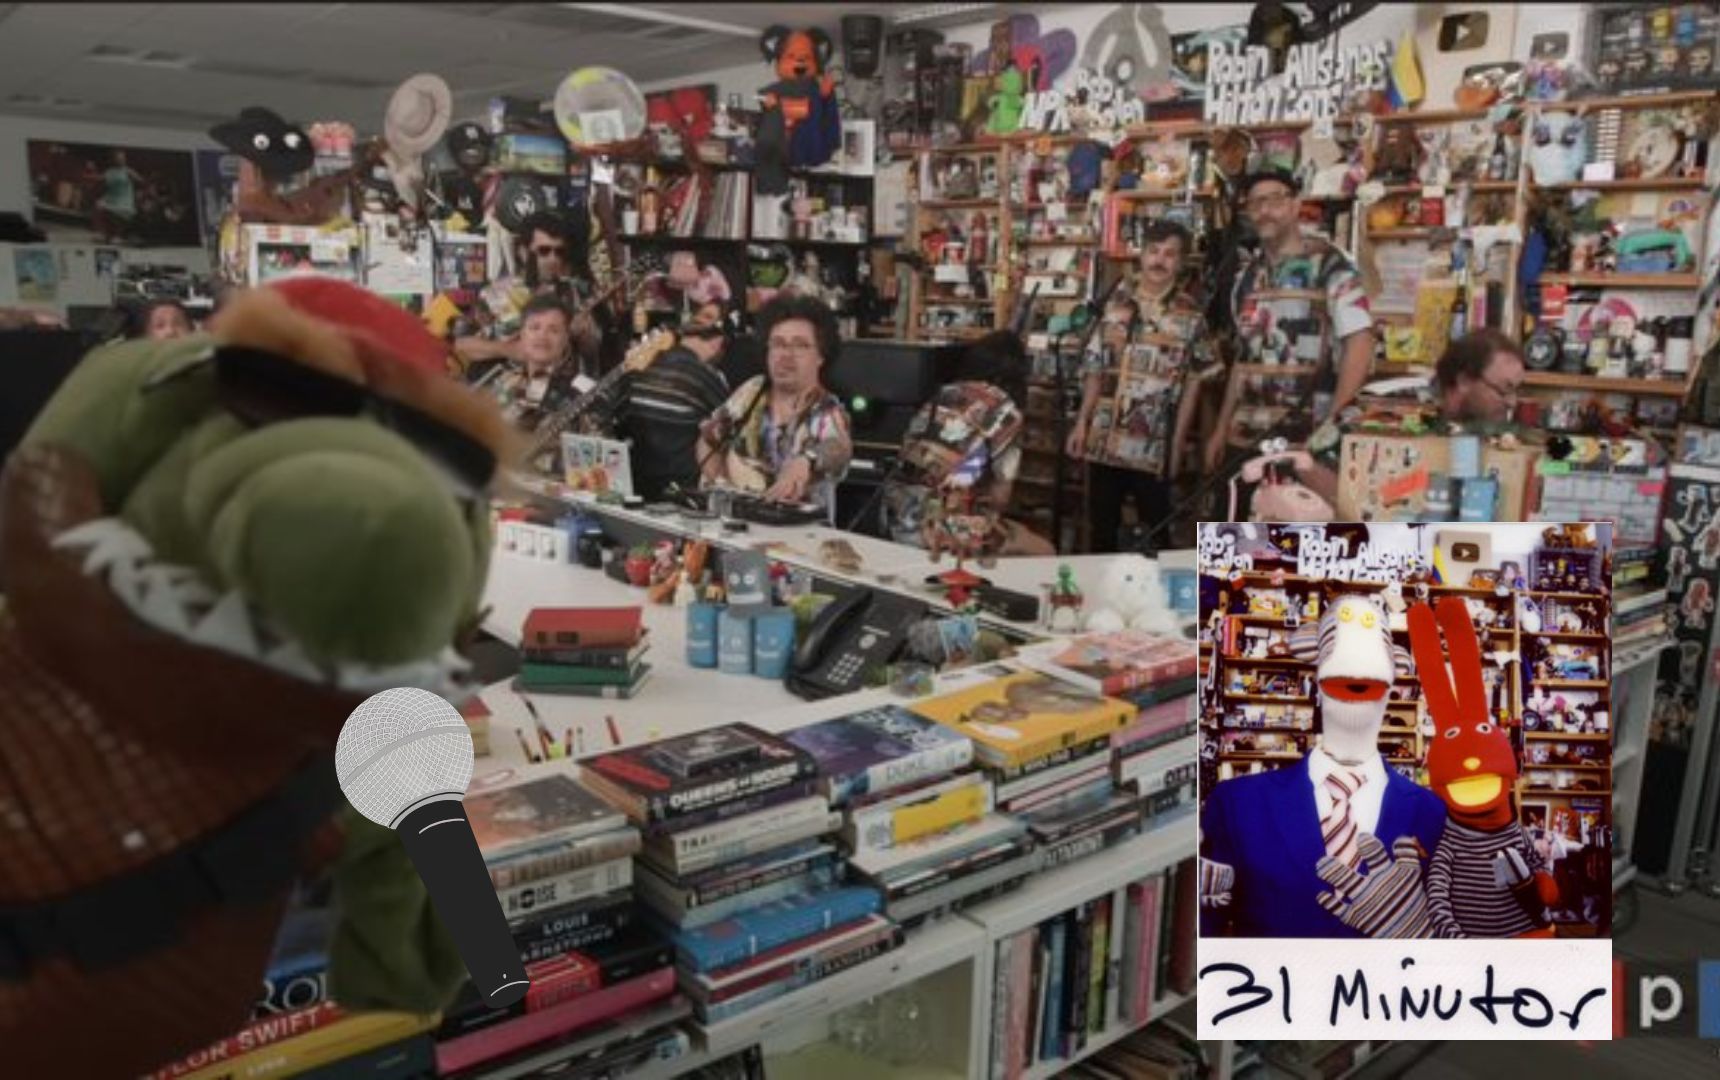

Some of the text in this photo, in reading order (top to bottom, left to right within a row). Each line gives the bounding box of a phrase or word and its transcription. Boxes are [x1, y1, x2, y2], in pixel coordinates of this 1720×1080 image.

[1206, 39, 1270, 83] Robin
[1199, 962, 1292, 1025] 31
[236, 1009, 320, 1050] SWIFT
